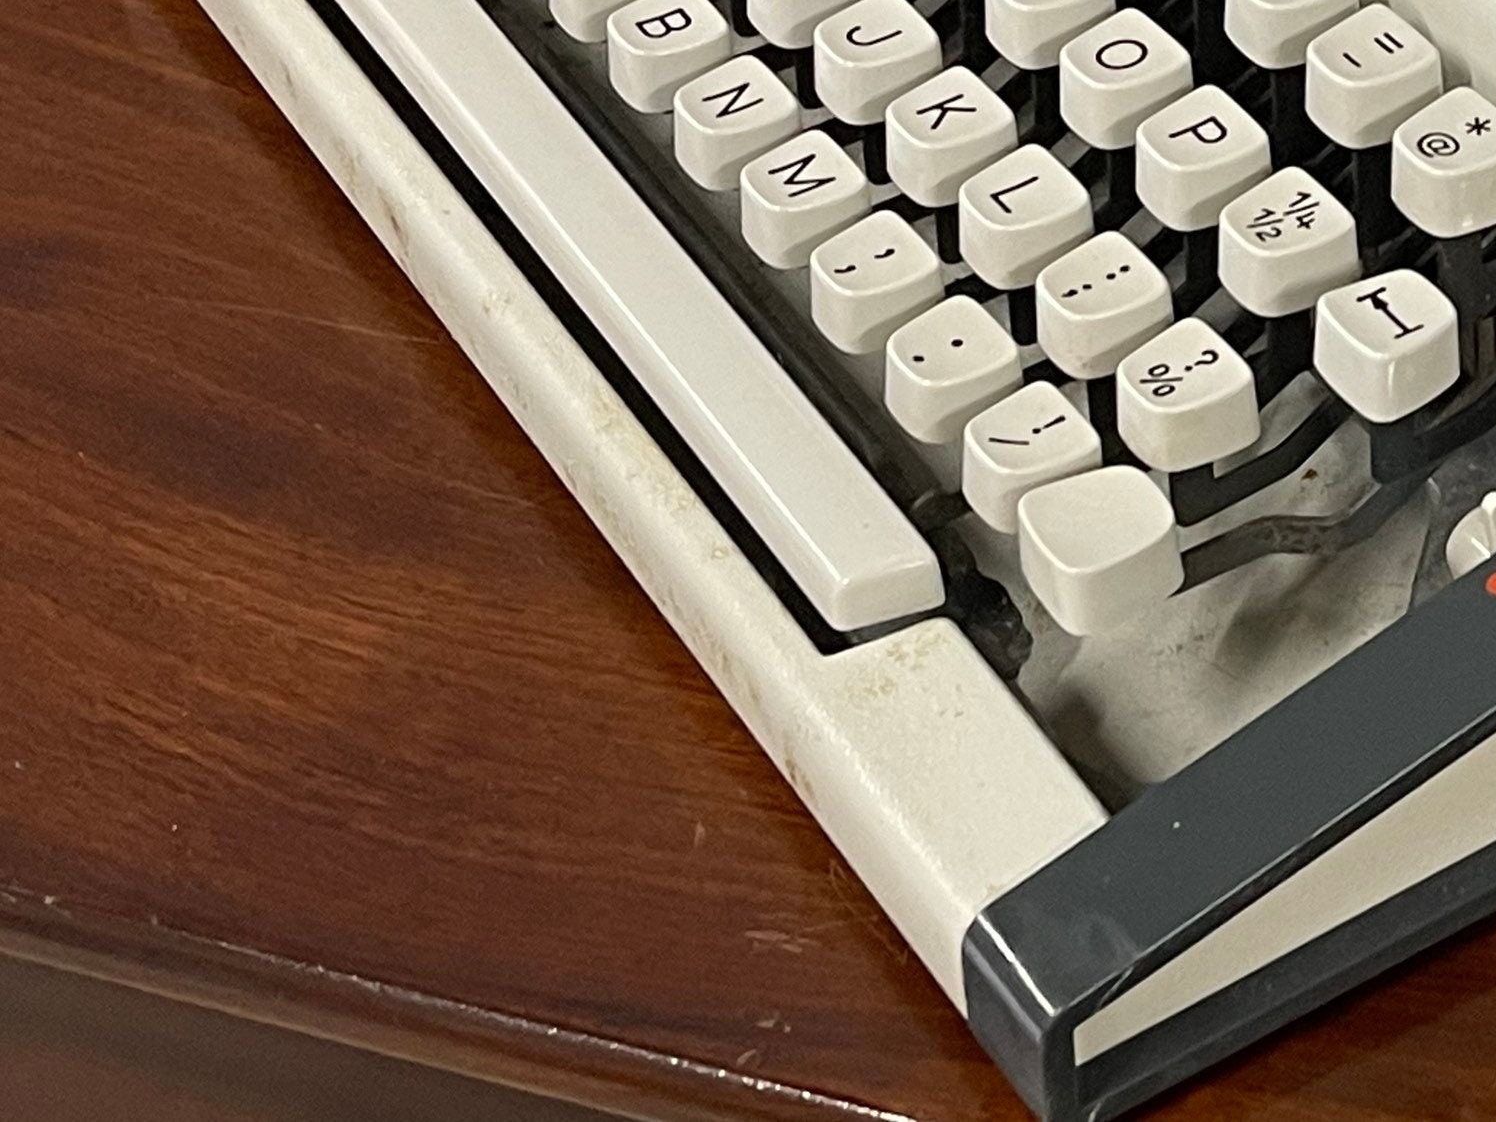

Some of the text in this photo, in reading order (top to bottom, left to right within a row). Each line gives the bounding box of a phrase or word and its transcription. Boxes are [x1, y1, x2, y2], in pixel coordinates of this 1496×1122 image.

[634, 7, 693, 39] B
[845, 25, 903, 47] J
[1095, 39, 1149, 71] O
[701, 82, 764, 119] N
[915, 93, 978, 130] K
[1168, 115, 1228, 144] P
[767, 152, 838, 199] M
[989, 176, 1039, 214] L
